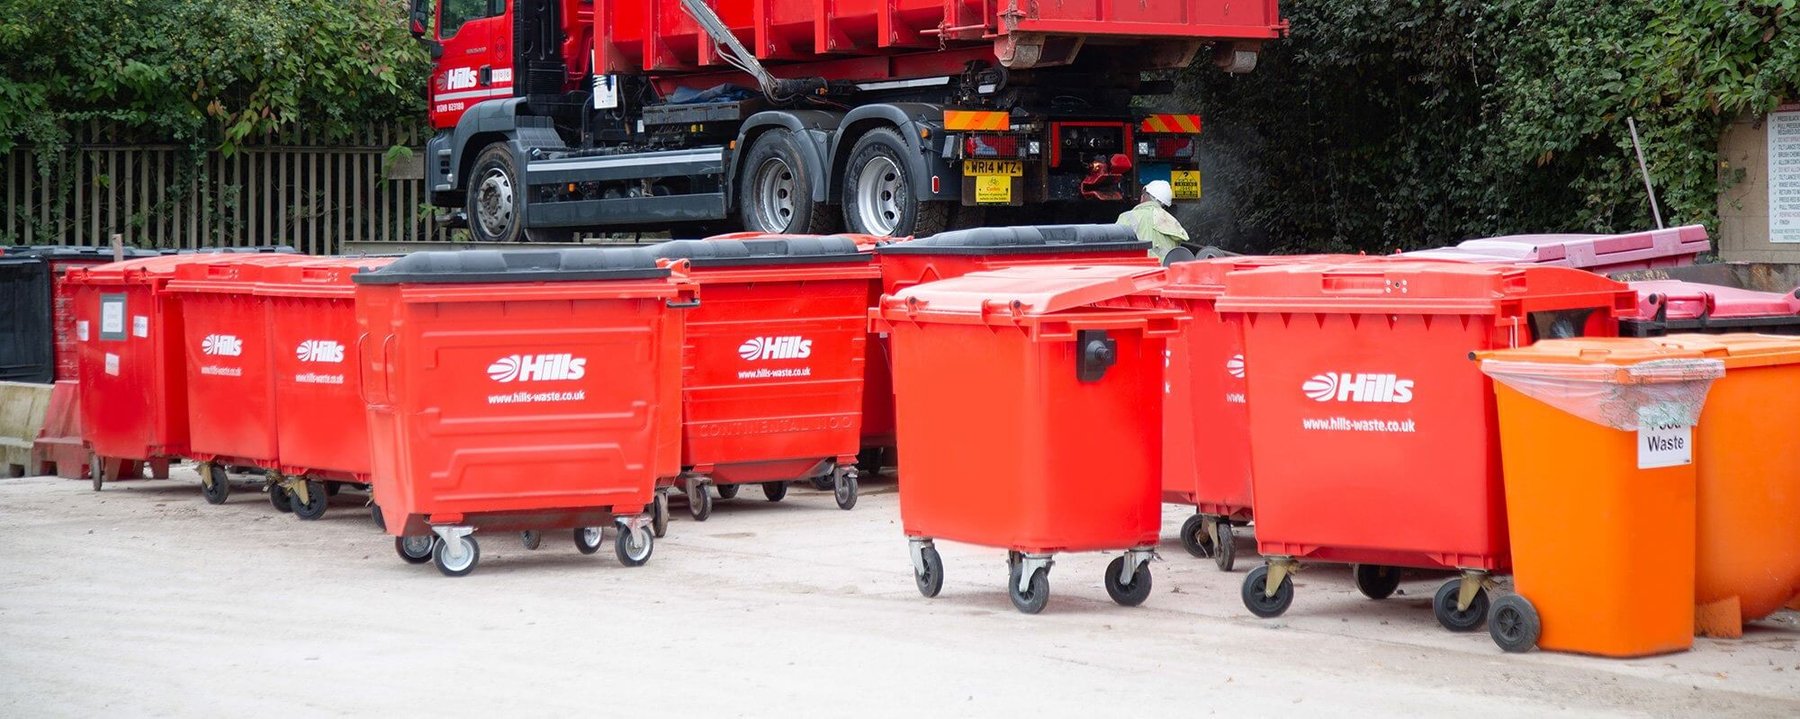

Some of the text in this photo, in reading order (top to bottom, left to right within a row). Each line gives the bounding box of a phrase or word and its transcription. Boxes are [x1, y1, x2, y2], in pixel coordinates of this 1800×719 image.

[447, 67, 478, 91] Hills
[971, 161, 1017, 174] WR14 MTZ
[214, 335, 243, 356] Hills
[311, 340, 346, 363] Hills
[762, 335, 813, 360] Hills
[519, 353, 587, 382] Hills
[738, 366, 811, 379] www.hills-waste.co.uk
[488, 390, 585, 404] www.hills-waste.co.uk
[1337, 372, 1415, 403] Hills
[1303, 417, 1416, 433] www.hills-waste.co.uk
[1647, 435, 1685, 453] Waste
